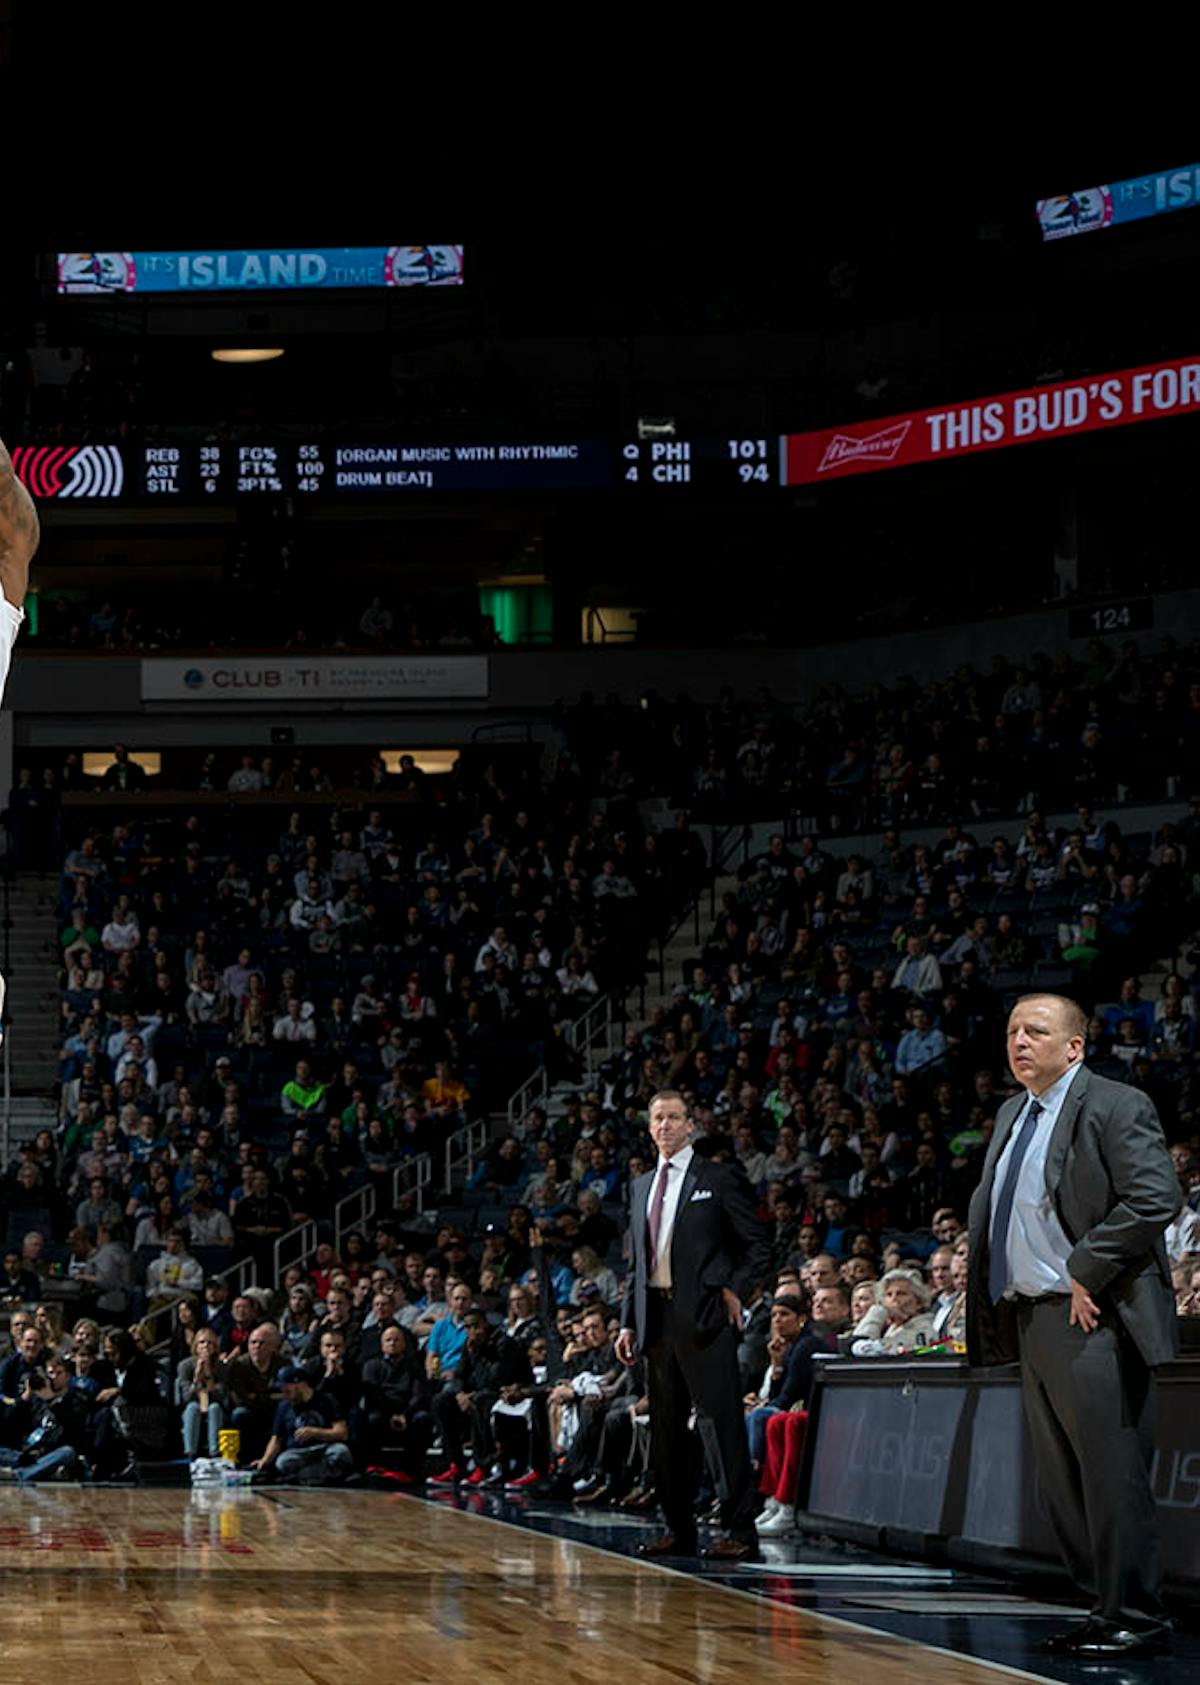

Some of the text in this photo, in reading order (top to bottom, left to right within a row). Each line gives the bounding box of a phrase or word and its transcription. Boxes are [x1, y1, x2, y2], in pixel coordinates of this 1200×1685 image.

[1155, 168, 1200, 210] IS
[143, 254, 376, 286] IT'S ISLAND TIME
[926, 402, 1004, 452] THIS
[1013, 379, 1123, 437] BUD'S
[1132, 363, 1200, 415] FOR
[146, 448, 180, 463] REB
[239, 446, 277, 461] FG%
[299, 445, 319, 460] 55
[336, 444, 579, 465] [ORGAN MUSIC WITH RHYTHMIC
[623, 439, 767, 461] Q PHI 101
[146, 461, 324, 479] AST 23 FT% 100
[336, 471, 433, 488] DRUM BEAT]
[625, 463, 770, 483] 4 CHI 94
[147, 477, 319, 493] STL 6 3PT% 45
[1089, 605, 1132, 632] 124
[211, 669, 282, 688] CLUB
[297, 669, 320, 687] TI
